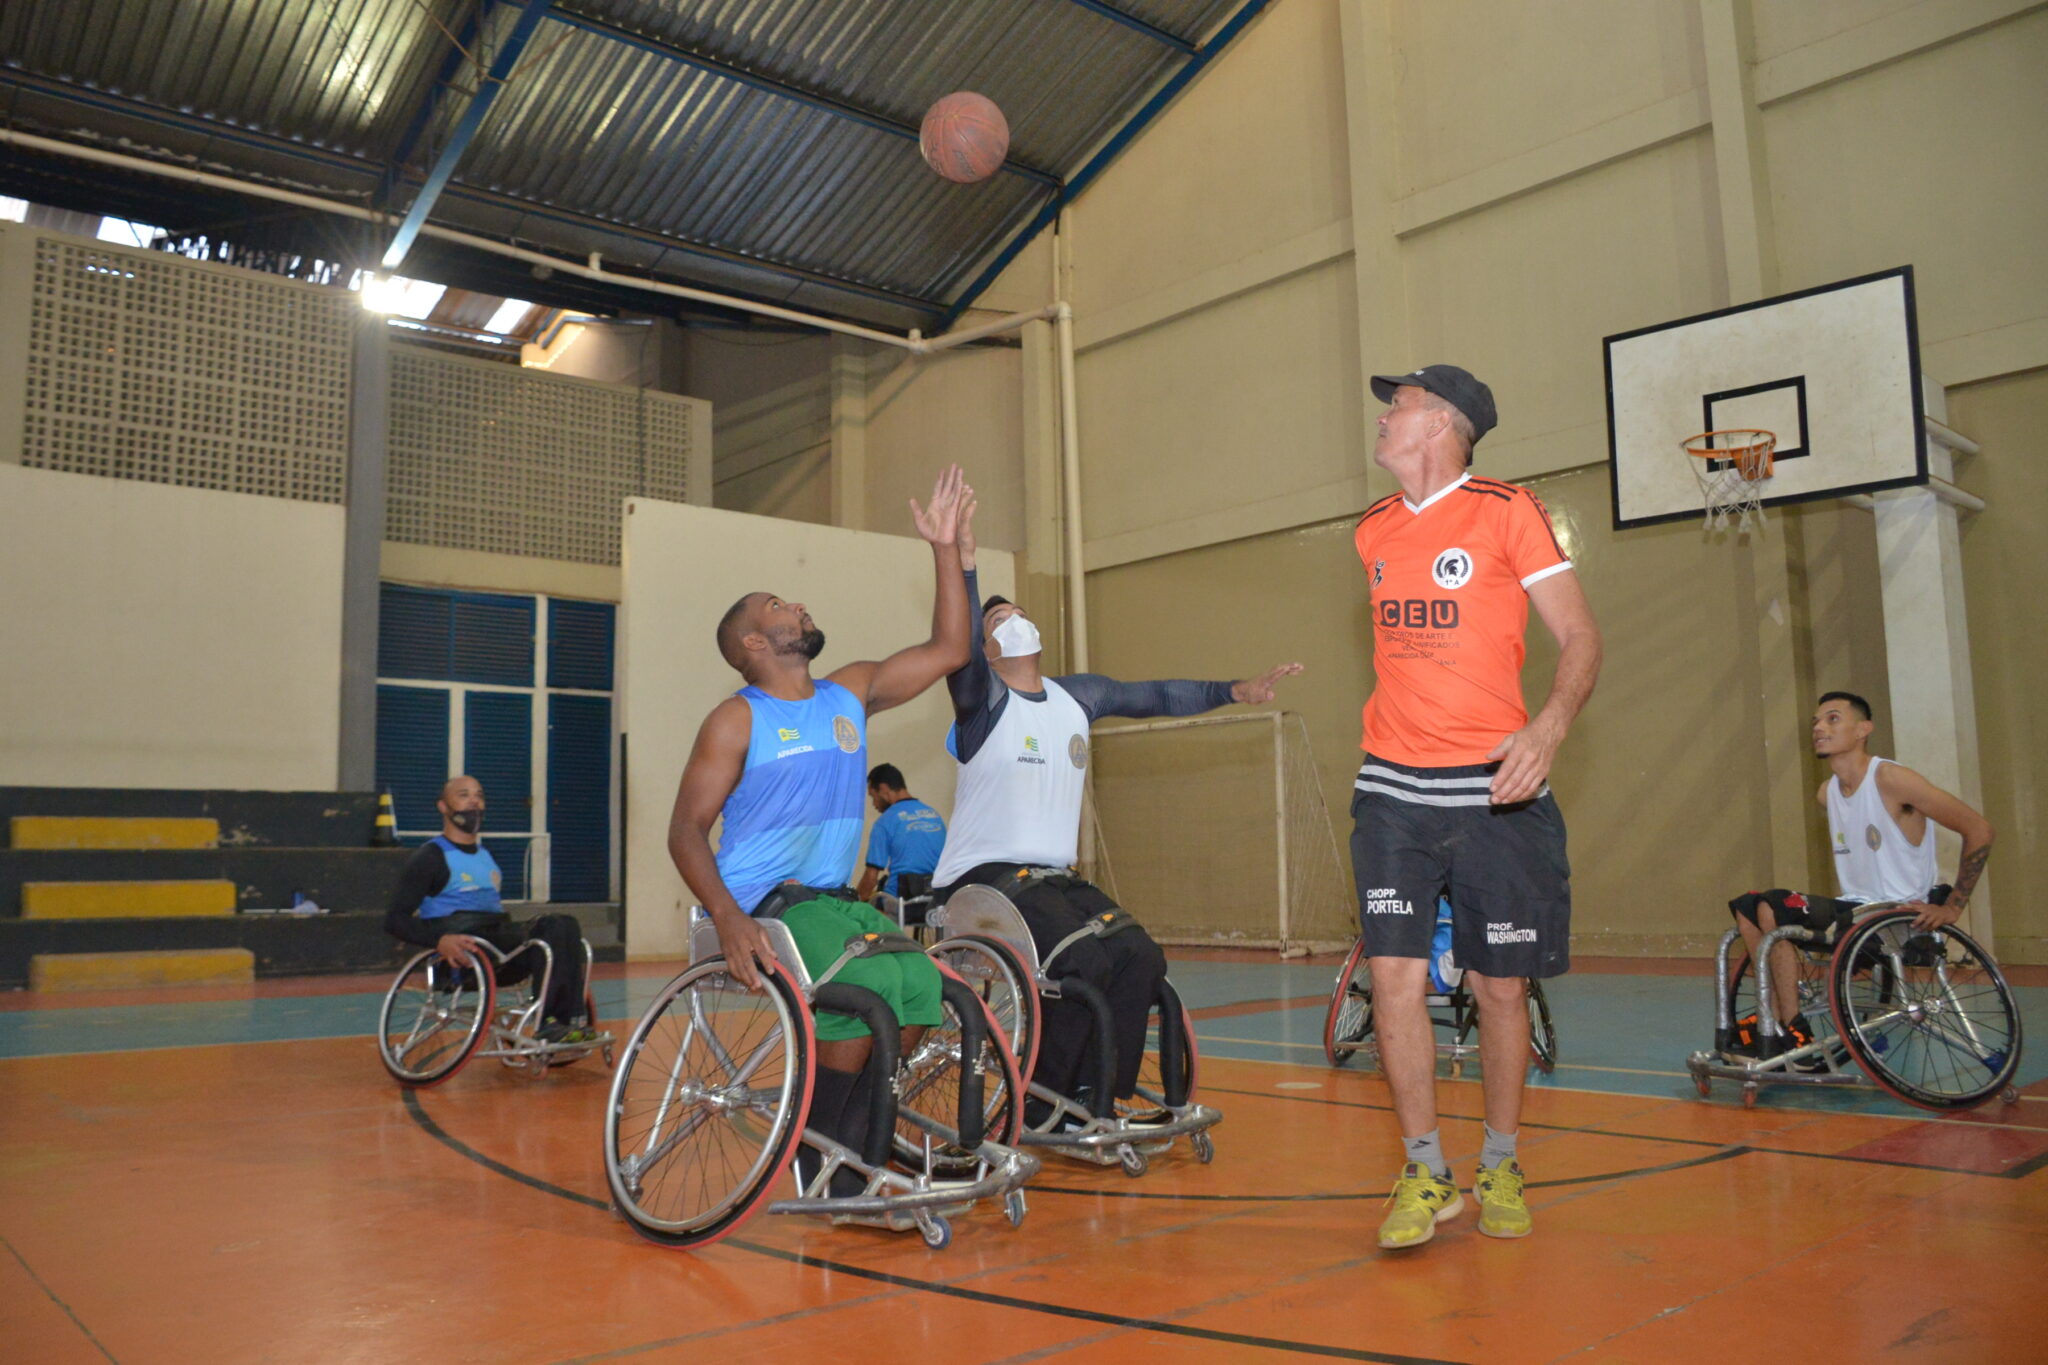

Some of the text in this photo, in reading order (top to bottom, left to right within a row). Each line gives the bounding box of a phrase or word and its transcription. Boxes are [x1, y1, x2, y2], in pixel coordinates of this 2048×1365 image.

[1381, 600, 1457, 627] CEU
[1366, 888, 1396, 899] CHOPP
[1366, 900, 1413, 915] PORTELA
[1487, 922, 1514, 931] PROF.
[1487, 929, 1537, 944] WASHINGTON
